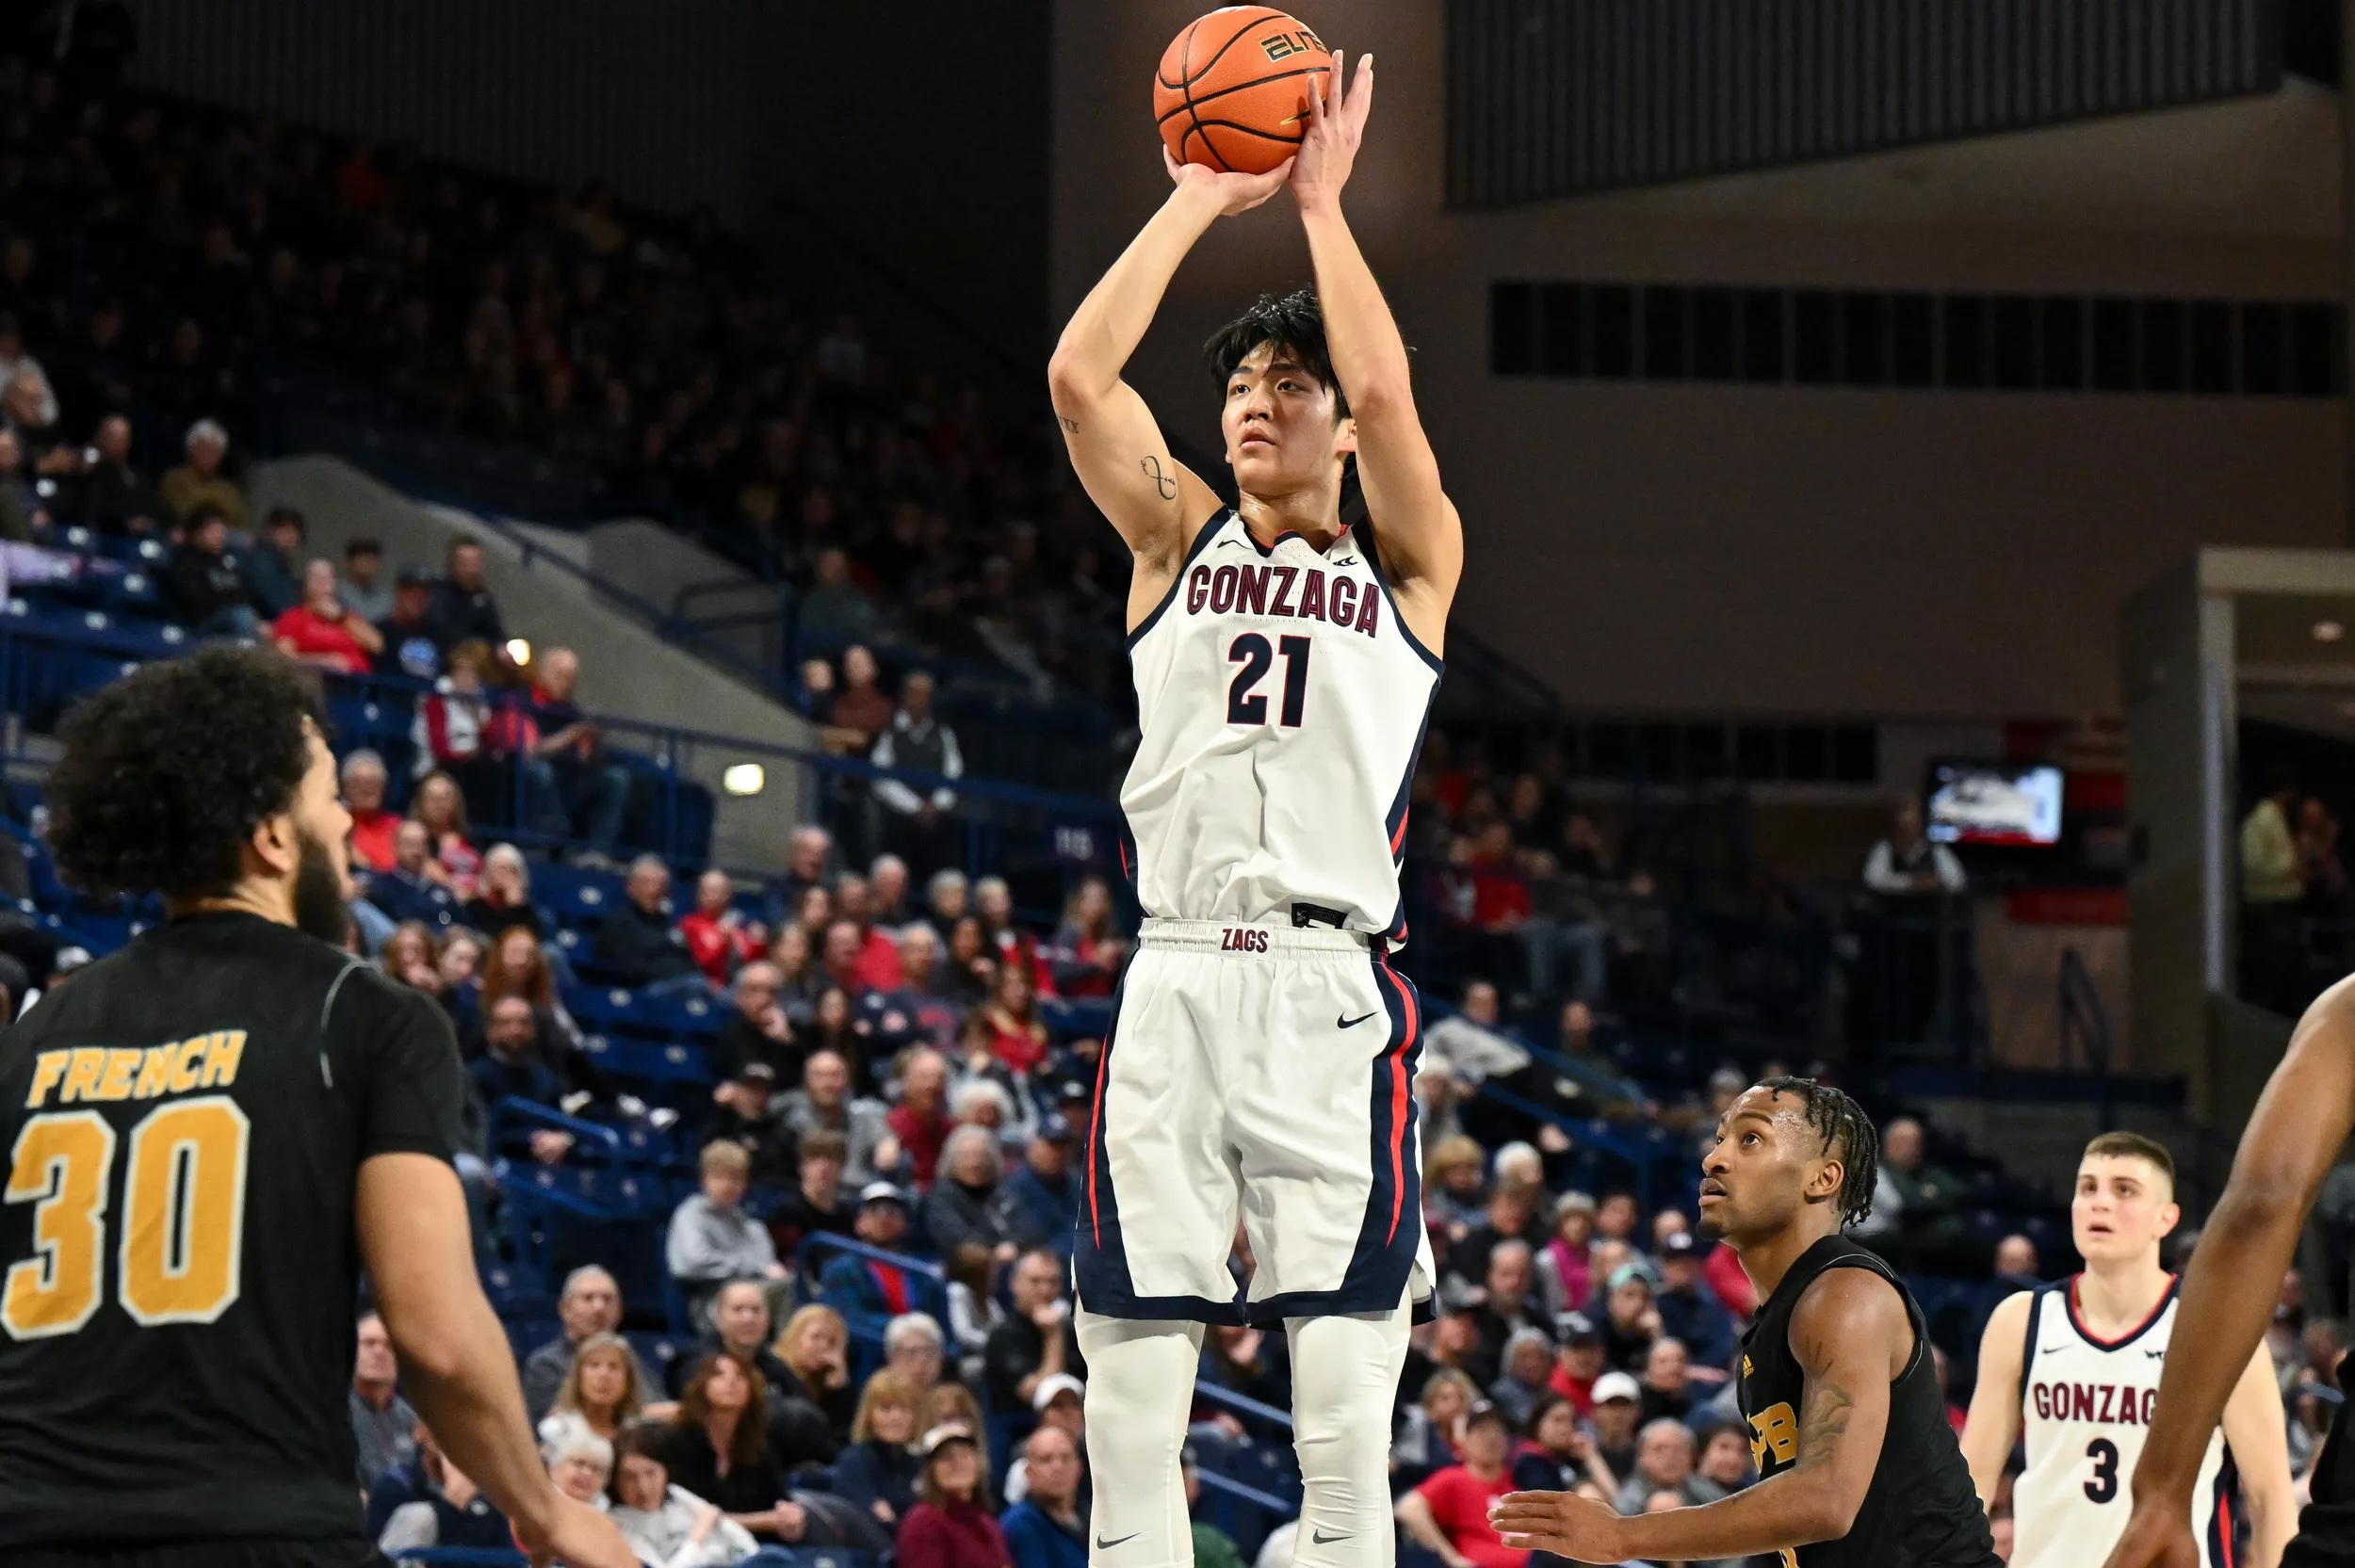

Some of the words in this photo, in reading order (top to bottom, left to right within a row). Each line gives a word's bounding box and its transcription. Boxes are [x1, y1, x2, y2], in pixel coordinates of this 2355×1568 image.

[1186, 564, 1380, 639] GONZAGA
[1226, 633, 1311, 728] 21
[1221, 928, 1269, 953] ZAGS
[25, 1029, 247, 1109] FRENCH
[0, 1094, 251, 1342] 30
[1746, 1401, 1798, 1475] PB
[2033, 1382, 2158, 1426] GONZAG
[2082, 1437, 2120, 1505] 3
